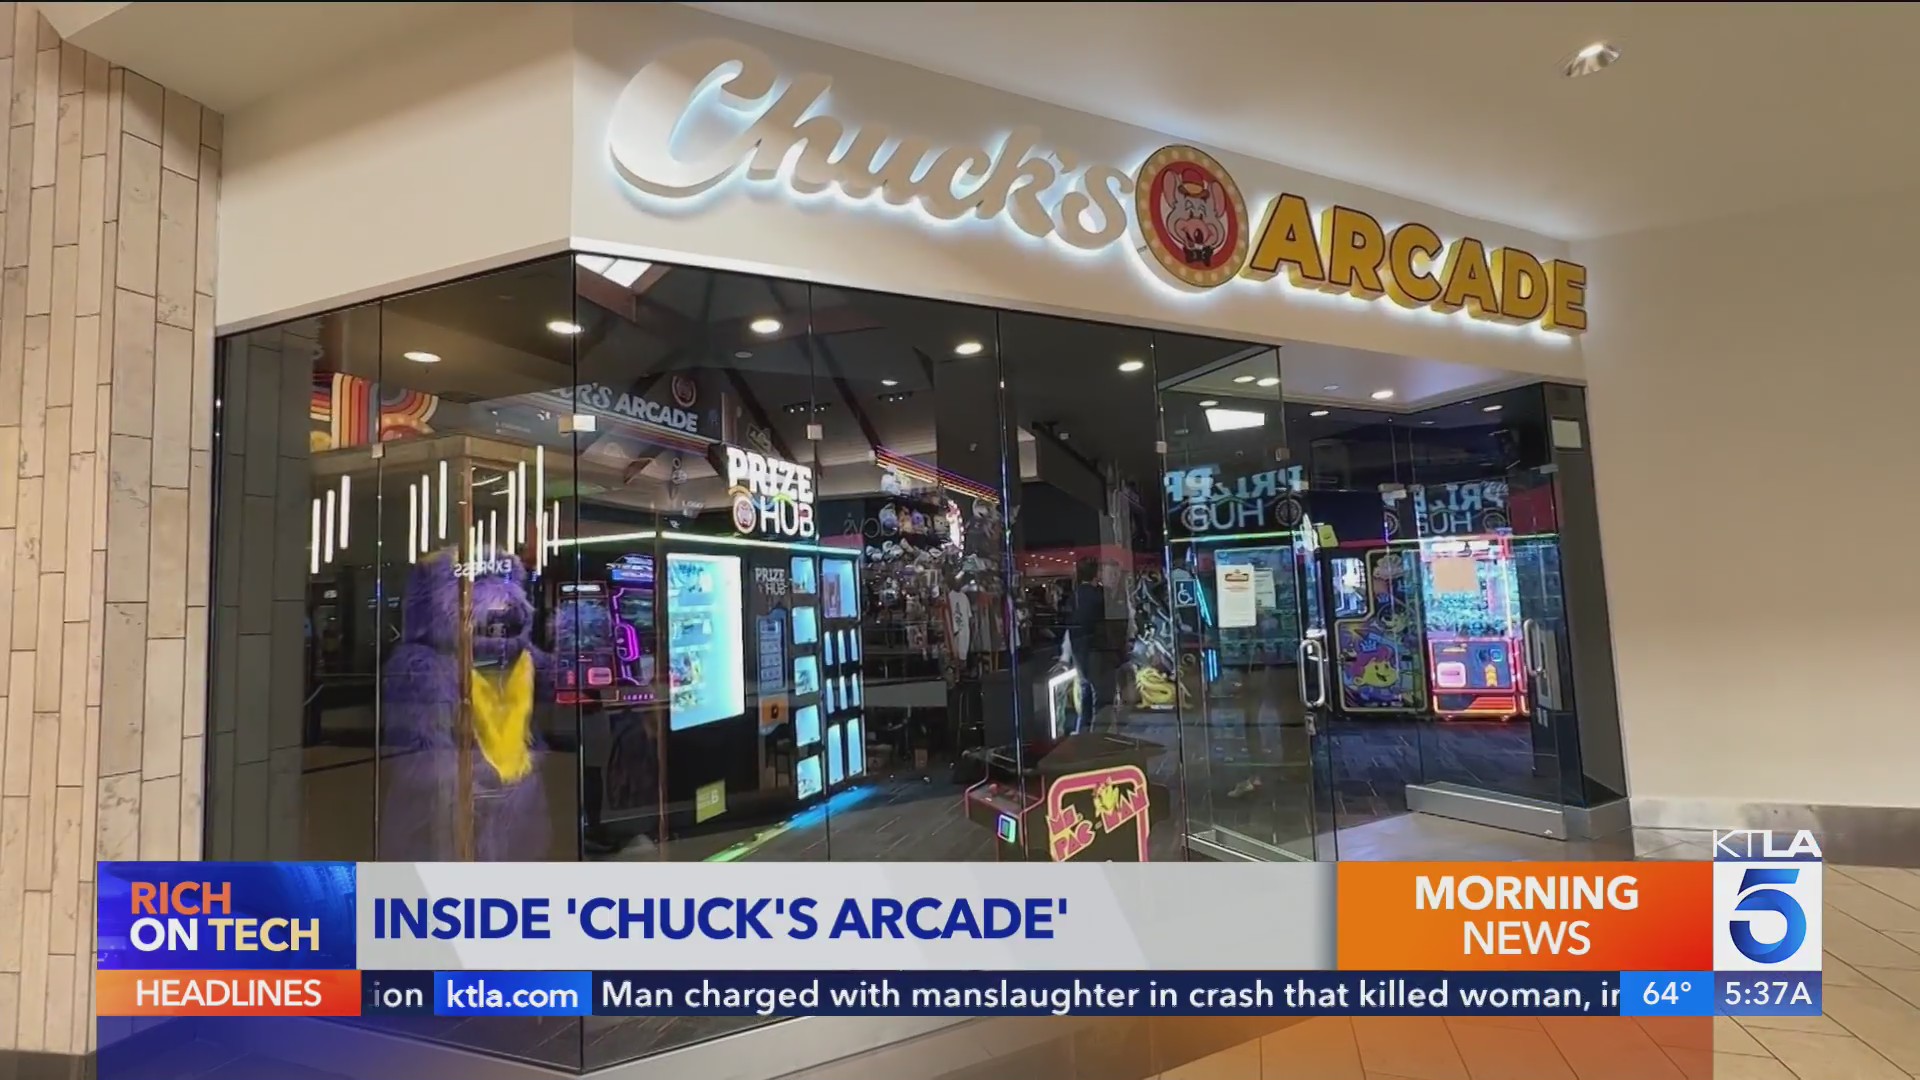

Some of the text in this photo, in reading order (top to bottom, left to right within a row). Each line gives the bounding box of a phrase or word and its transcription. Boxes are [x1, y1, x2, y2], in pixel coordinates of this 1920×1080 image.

[608, 37, 1587, 335] Chuck's ARCADE
[614, 393, 698, 432] ARCADE
[727, 447, 814, 504] PRIZE
[760, 496, 815, 537] HUB
[754, 567, 786, 583] PRIZE
[765, 581, 786, 596] HUB
